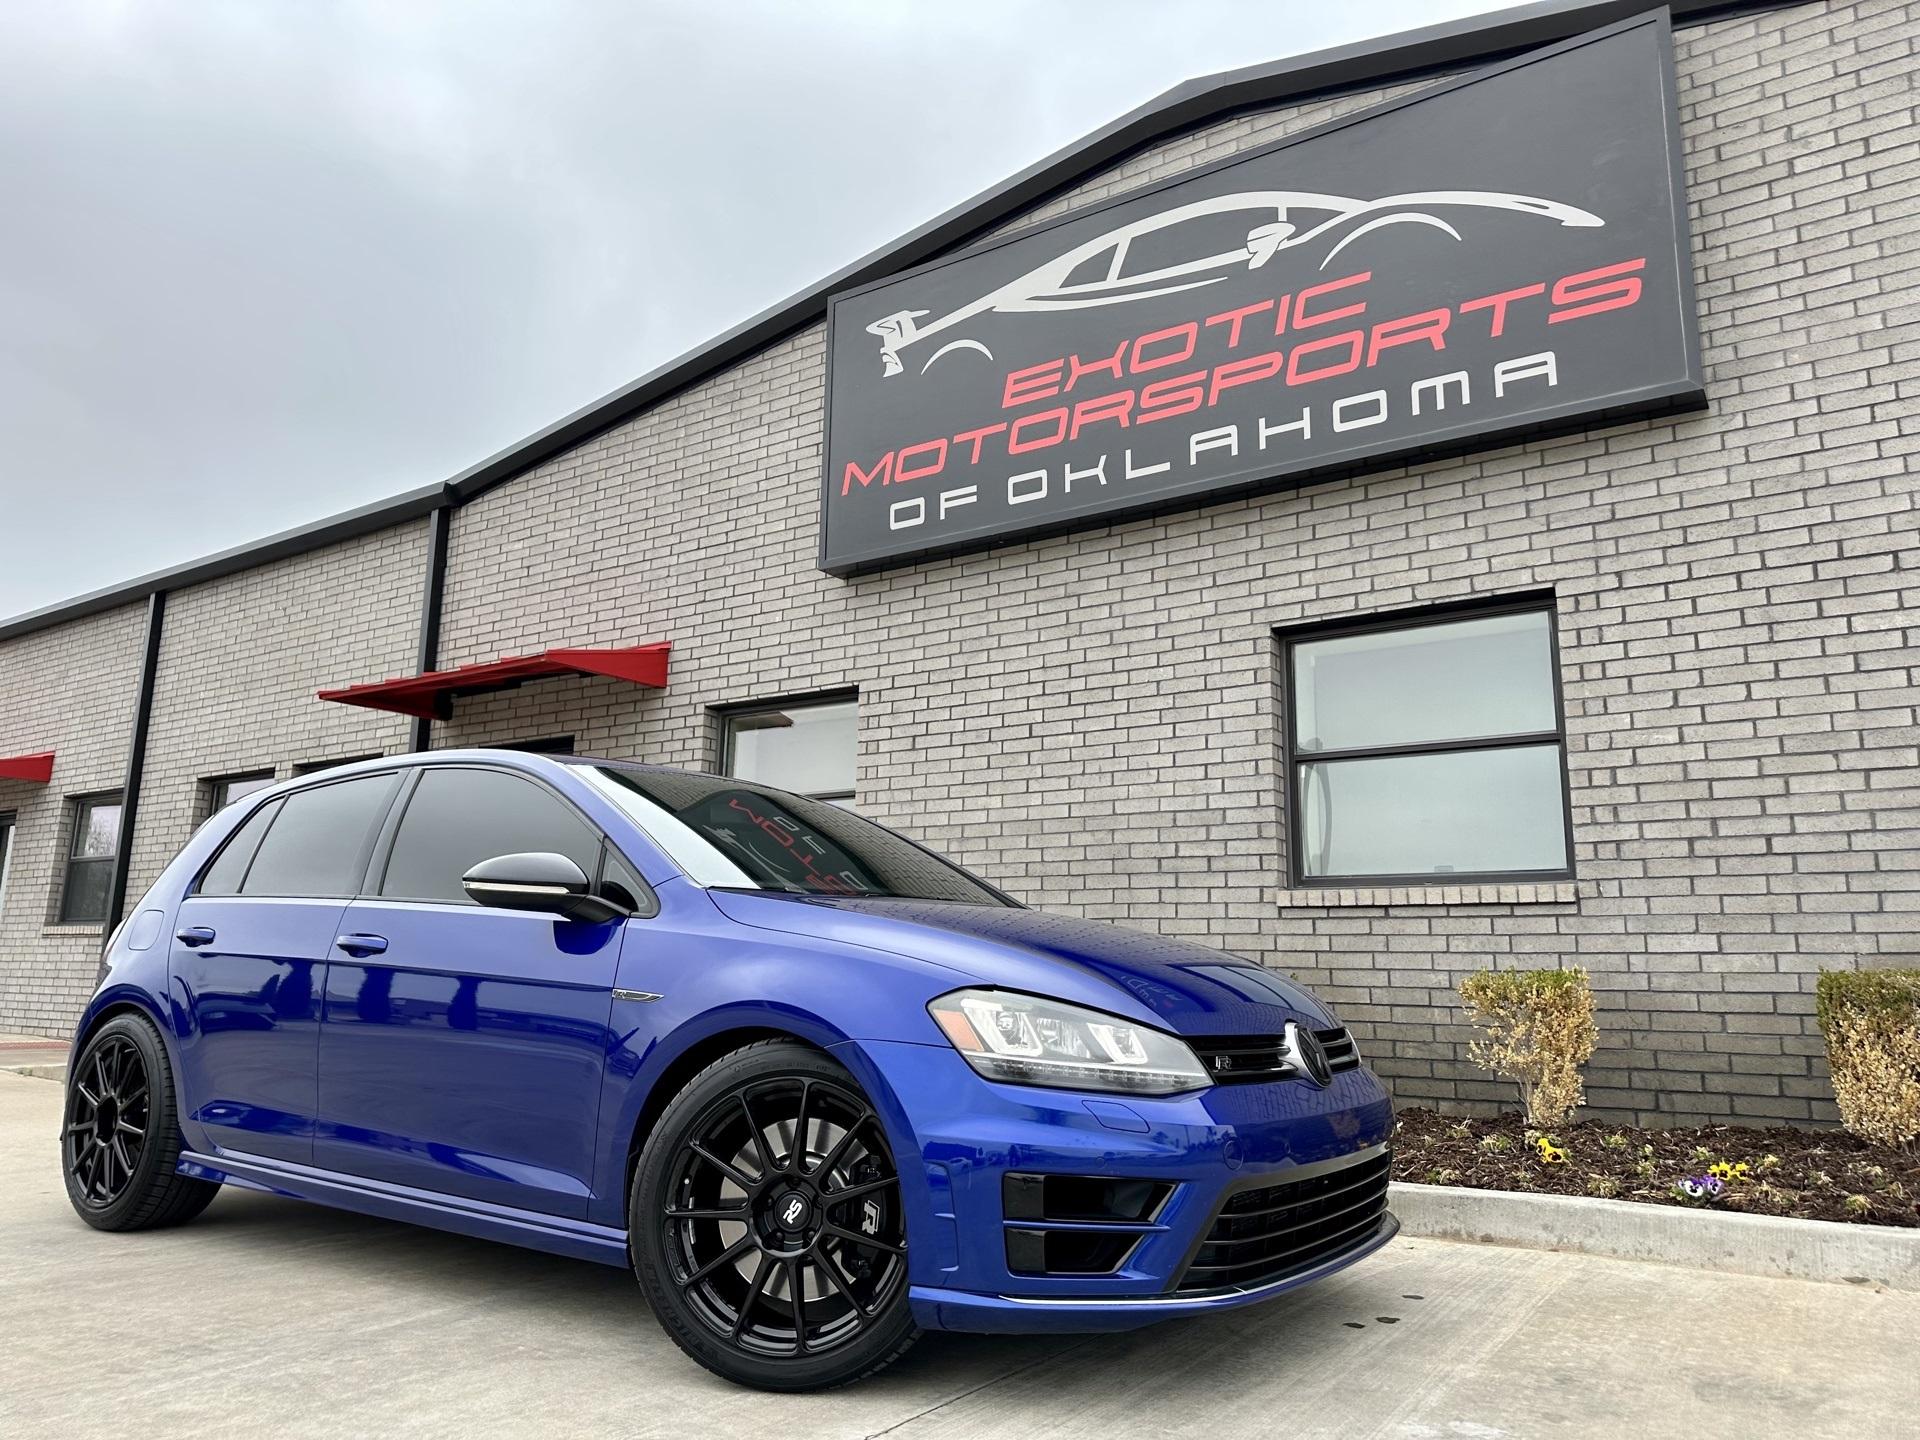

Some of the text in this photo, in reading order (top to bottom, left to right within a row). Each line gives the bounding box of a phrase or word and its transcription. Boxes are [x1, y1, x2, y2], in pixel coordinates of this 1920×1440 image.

[842, 258, 1646, 494] MOTORSPORTS
[1002, 272, 1372, 408] EXOTIC
[888, 350, 1559, 532] OF OKLAHOMA
